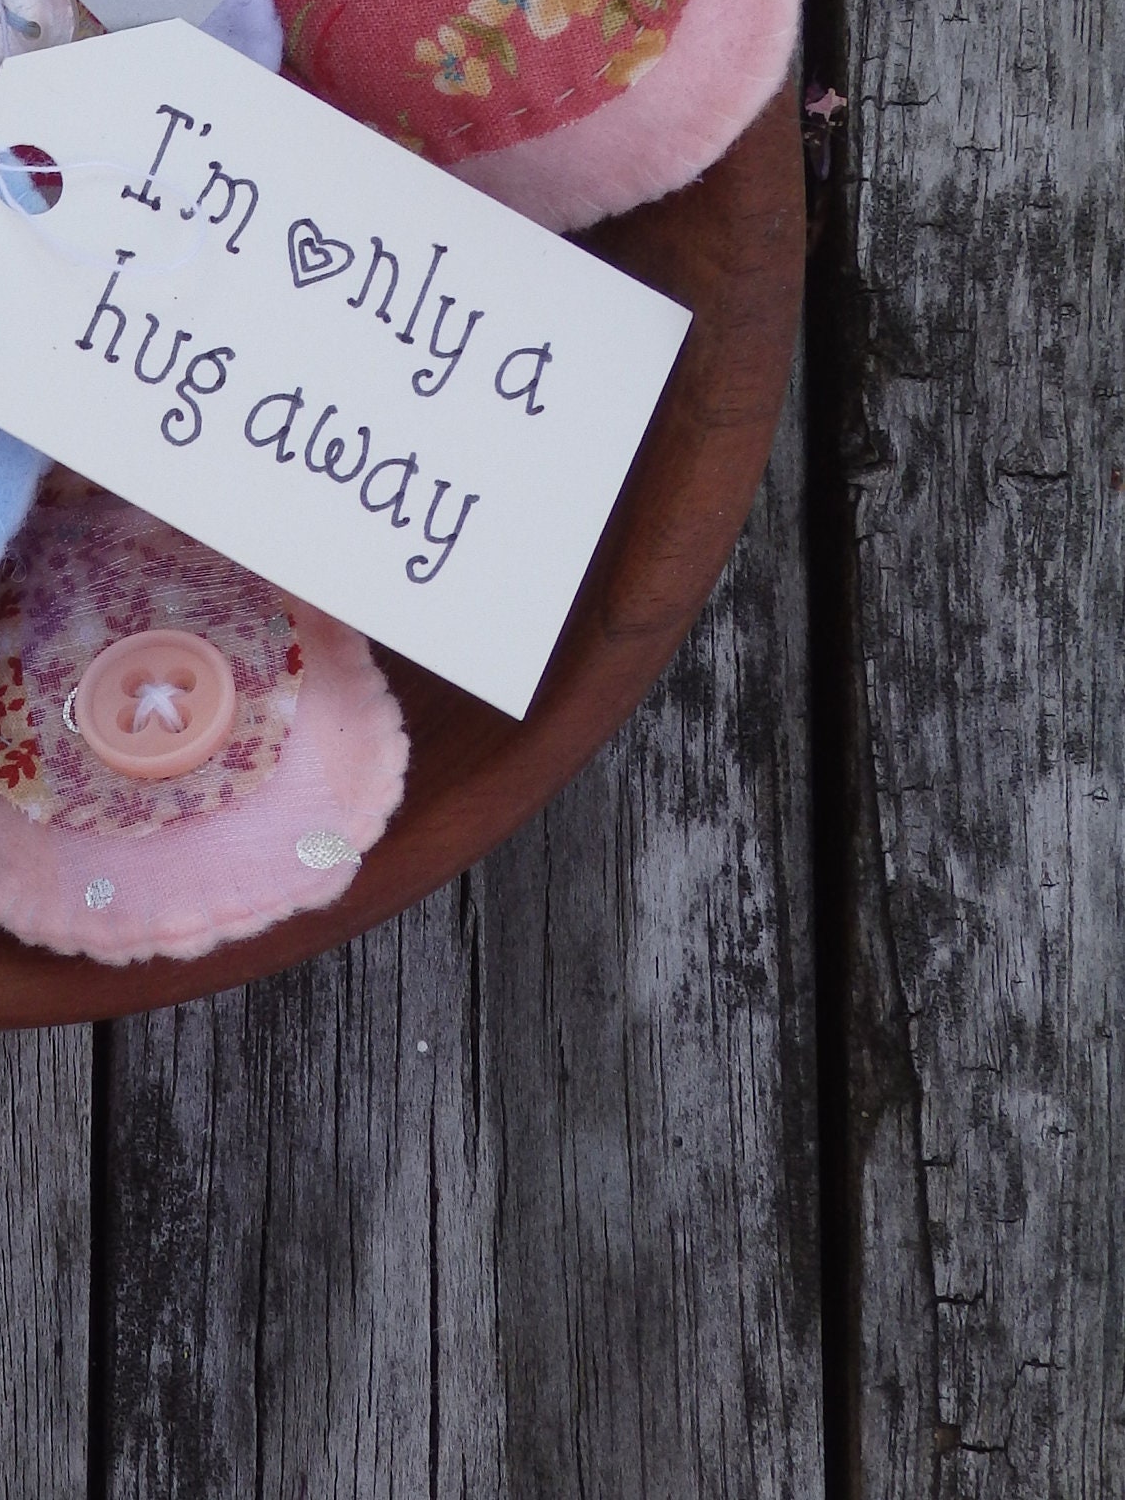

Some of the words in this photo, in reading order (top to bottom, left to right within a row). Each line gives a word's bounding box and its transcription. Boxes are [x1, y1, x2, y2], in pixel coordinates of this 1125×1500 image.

[75, 249, 236, 447] hug
[244, 387, 480, 584] away
[121, 104, 259, 254] I'm
[495, 342, 552, 416] a
